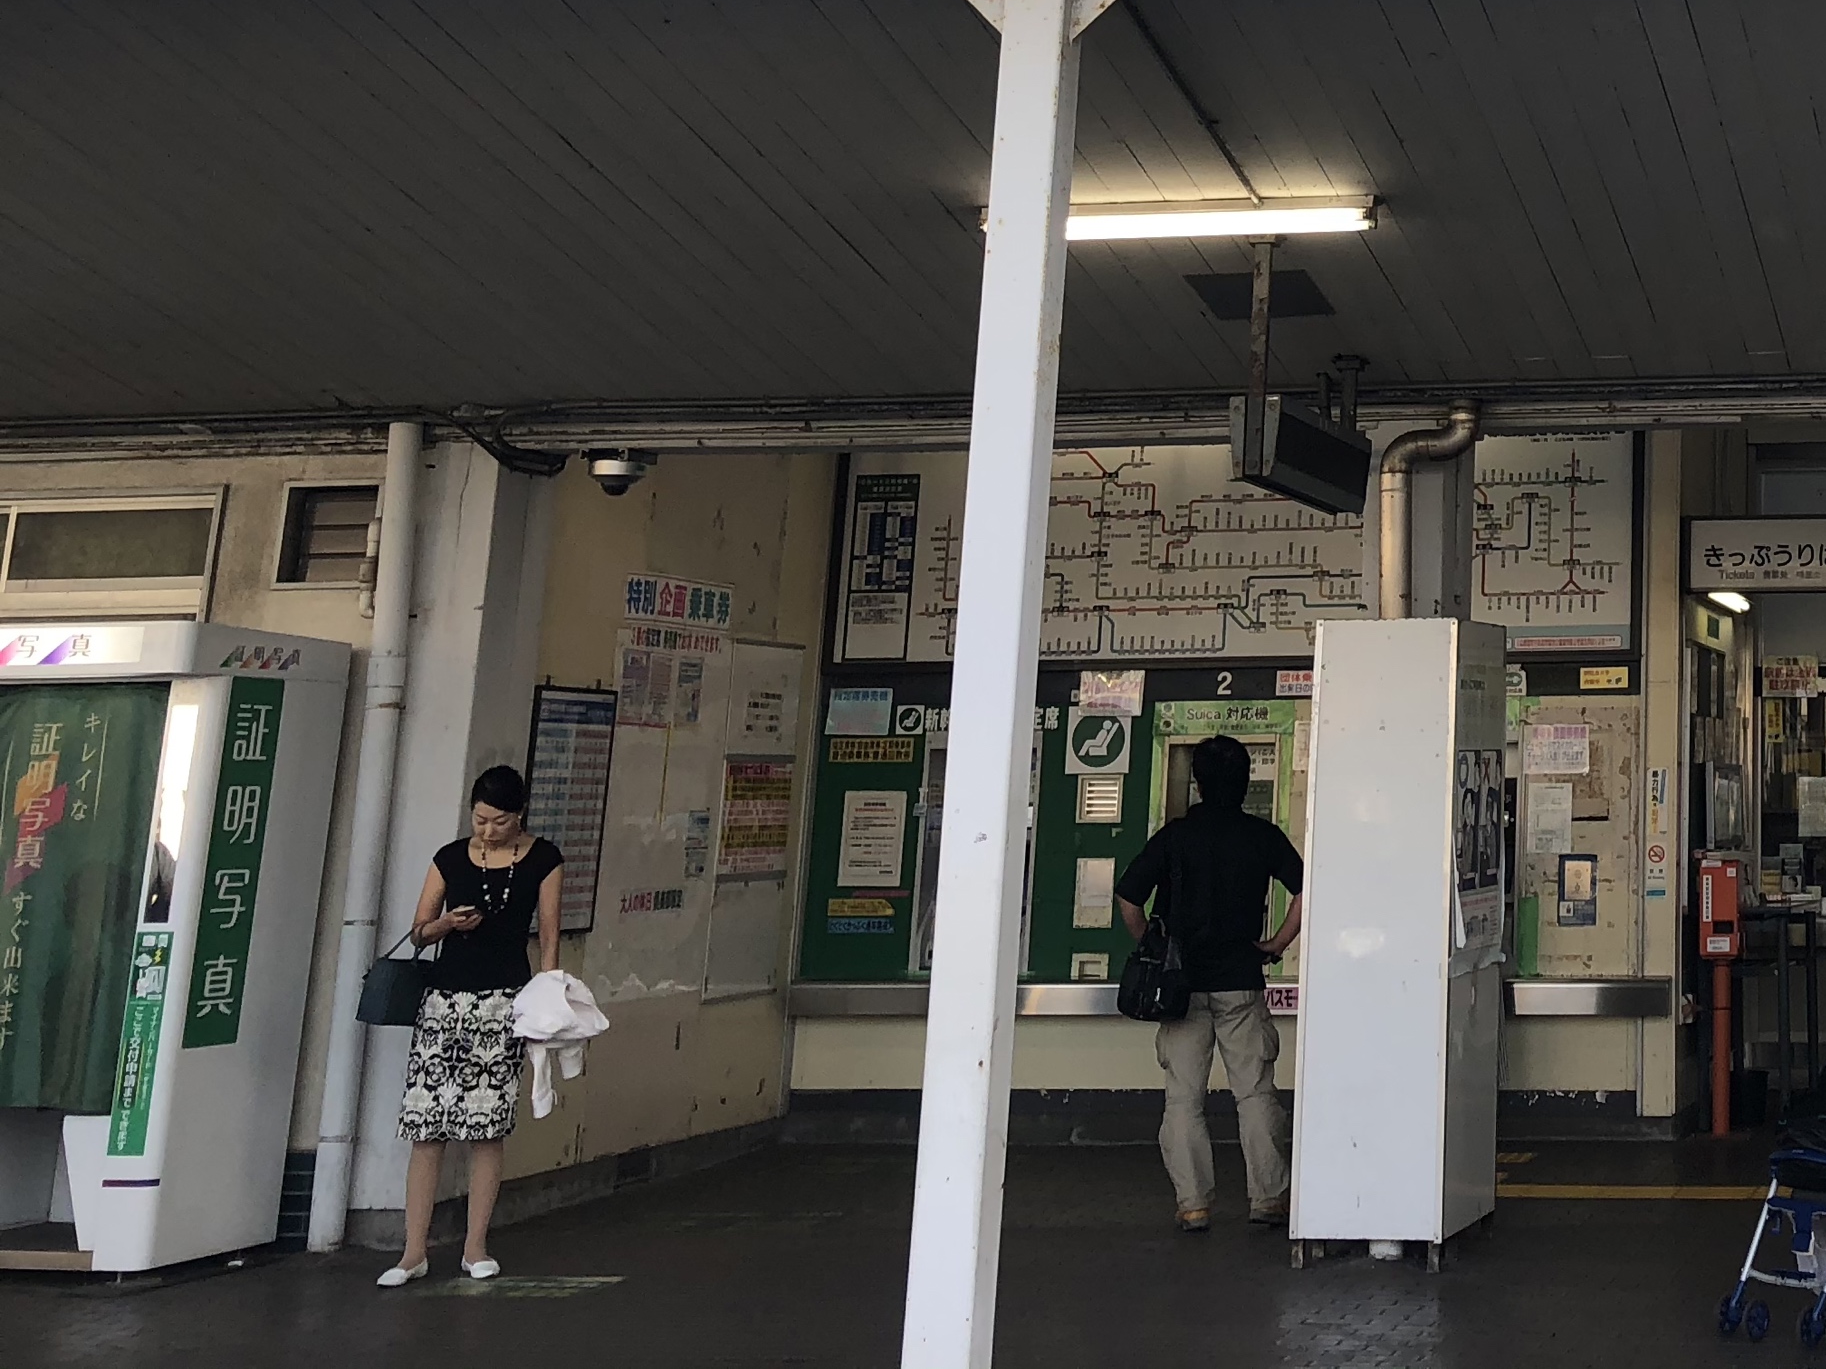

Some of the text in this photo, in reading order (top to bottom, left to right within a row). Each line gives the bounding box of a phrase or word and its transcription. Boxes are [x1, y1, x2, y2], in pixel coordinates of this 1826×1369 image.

[626, 577, 730, 625] 特別企画乗車券
[1186, 706, 1269, 721] Suica 対応機
[1216, 671, 1233, 696] 2
[14, 722, 64, 869] 証明写真
[70, 712, 102, 822] キレイな
[197, 704, 273, 1018] 証明写真
